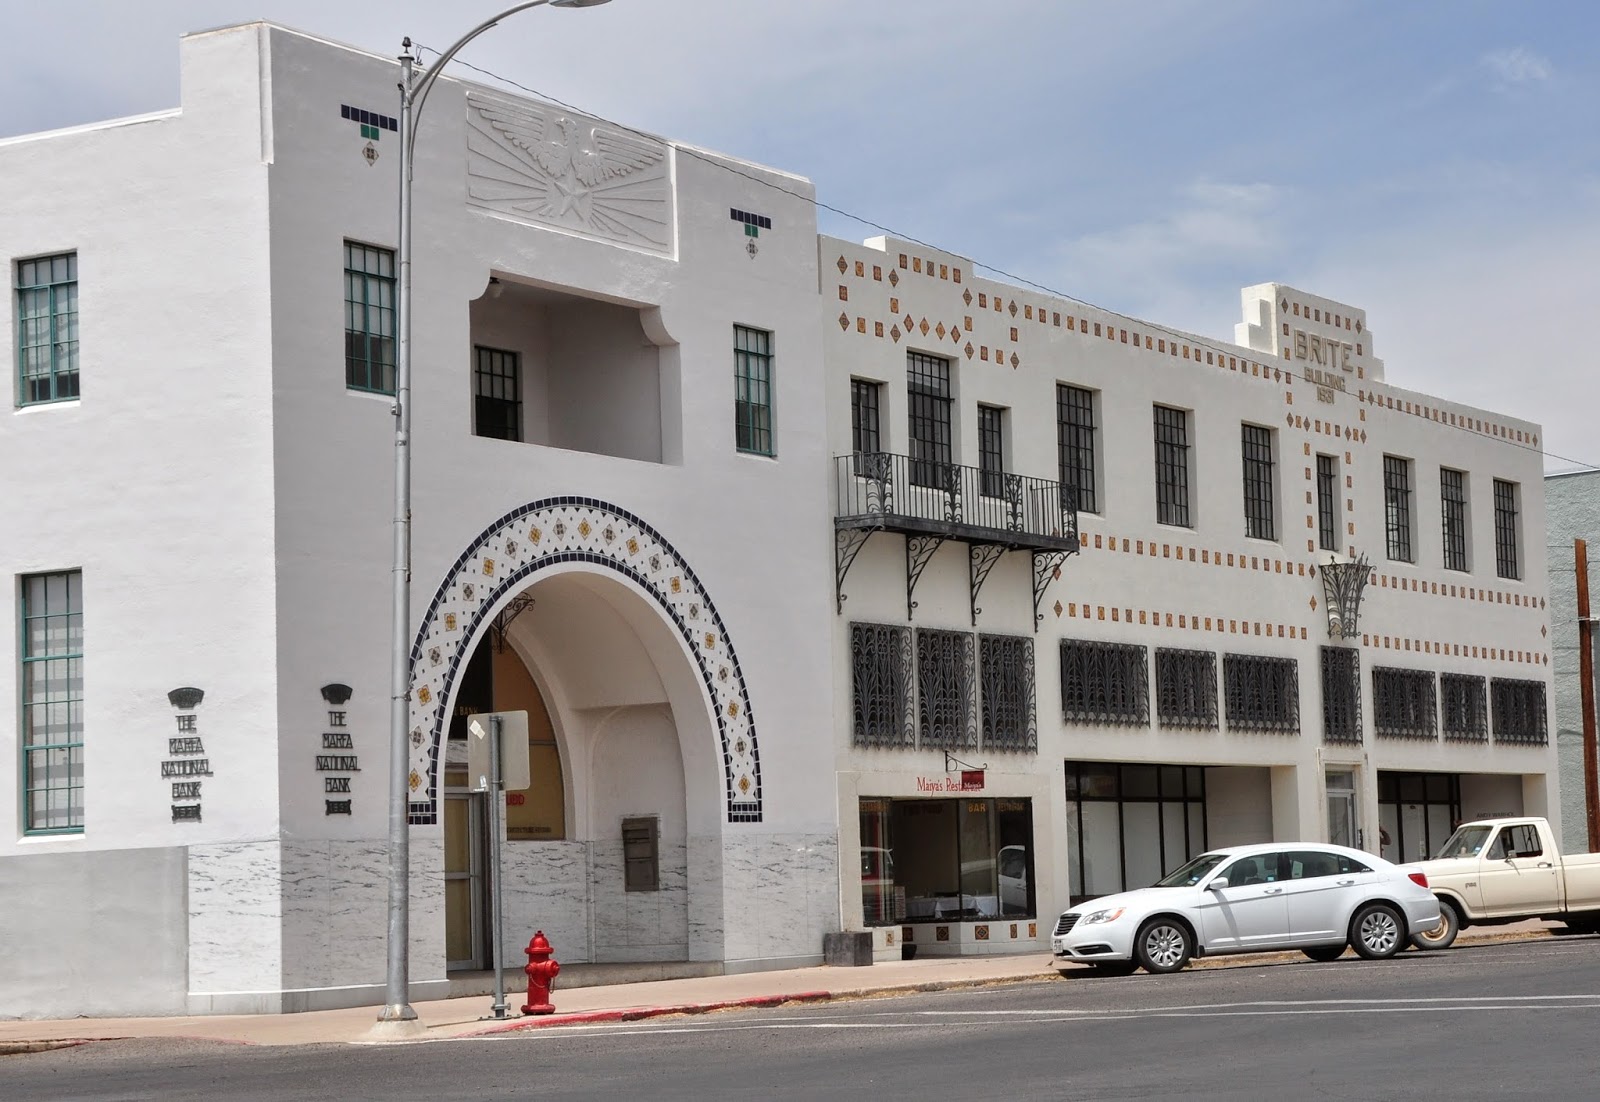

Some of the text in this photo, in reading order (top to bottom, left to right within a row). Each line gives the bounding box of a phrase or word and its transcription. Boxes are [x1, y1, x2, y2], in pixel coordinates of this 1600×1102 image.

[1294, 329, 1354, 373] BRITE
[1304, 366, 1346, 393] BUILDING
[1317, 386, 1335, 405] 1931
[175, 714, 197, 731] THE
[328, 711, 347, 727] THE
[169, 737, 205, 754] MARFA
[322, 733, 353, 749] MARFA
[161, 759, 214, 777] NATIONAL
[316, 755, 361, 771] NATIONAL
[172, 781, 201, 799] BANK
[325, 777, 351, 793] BANK
[917, 776, 943, 798] Maiya's
[968, 803, 986, 813] BAR
